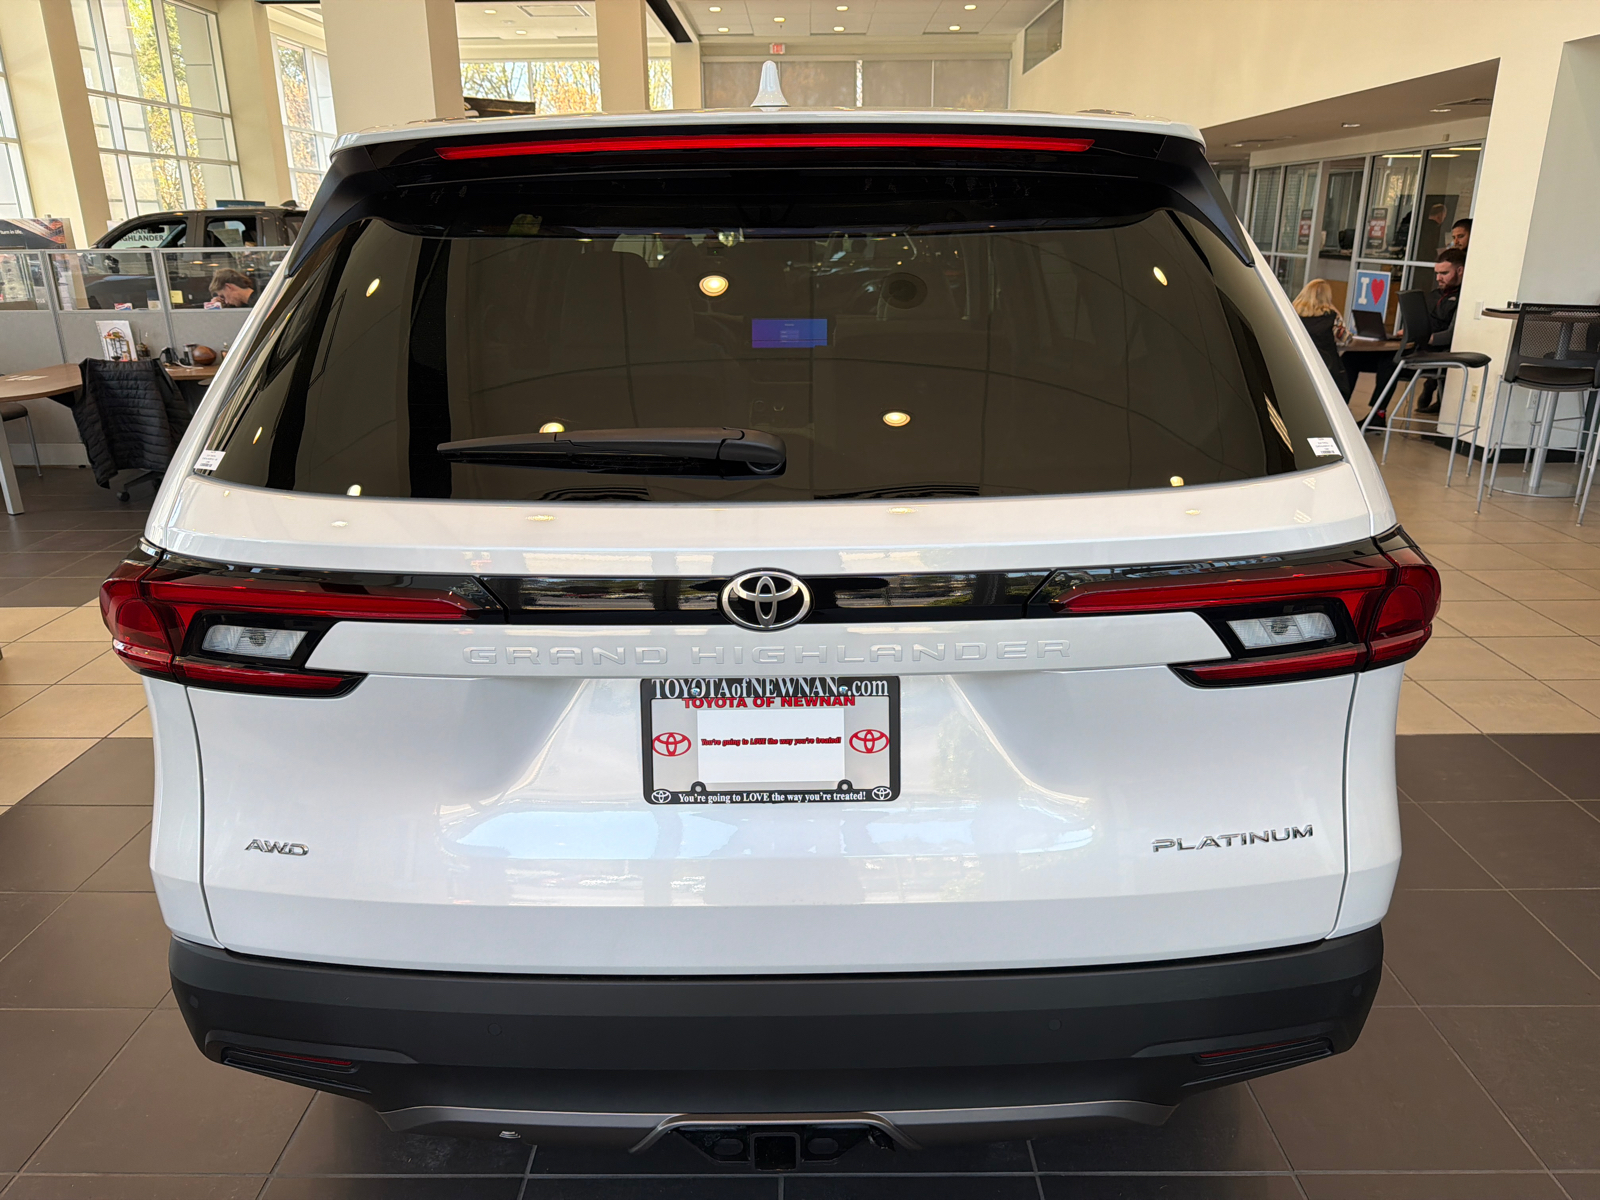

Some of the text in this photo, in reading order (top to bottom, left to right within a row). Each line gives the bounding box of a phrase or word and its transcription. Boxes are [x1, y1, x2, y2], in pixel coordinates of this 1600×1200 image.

[463, 639, 1071, 665] GRAND HIGHLANDER
[681, 695, 857, 709] TOYOTA OF NEWNAN
[722, 738, 741, 747] going
[750, 737, 767, 745] LOVE
[767, 737, 778, 745] the
[779, 738, 793, 746] way
[678, 791, 866, 804] You're going to LOVE the way you're treated!
[1151, 824, 1314, 853] PLATINUM
[244, 838, 310, 857] AWD
